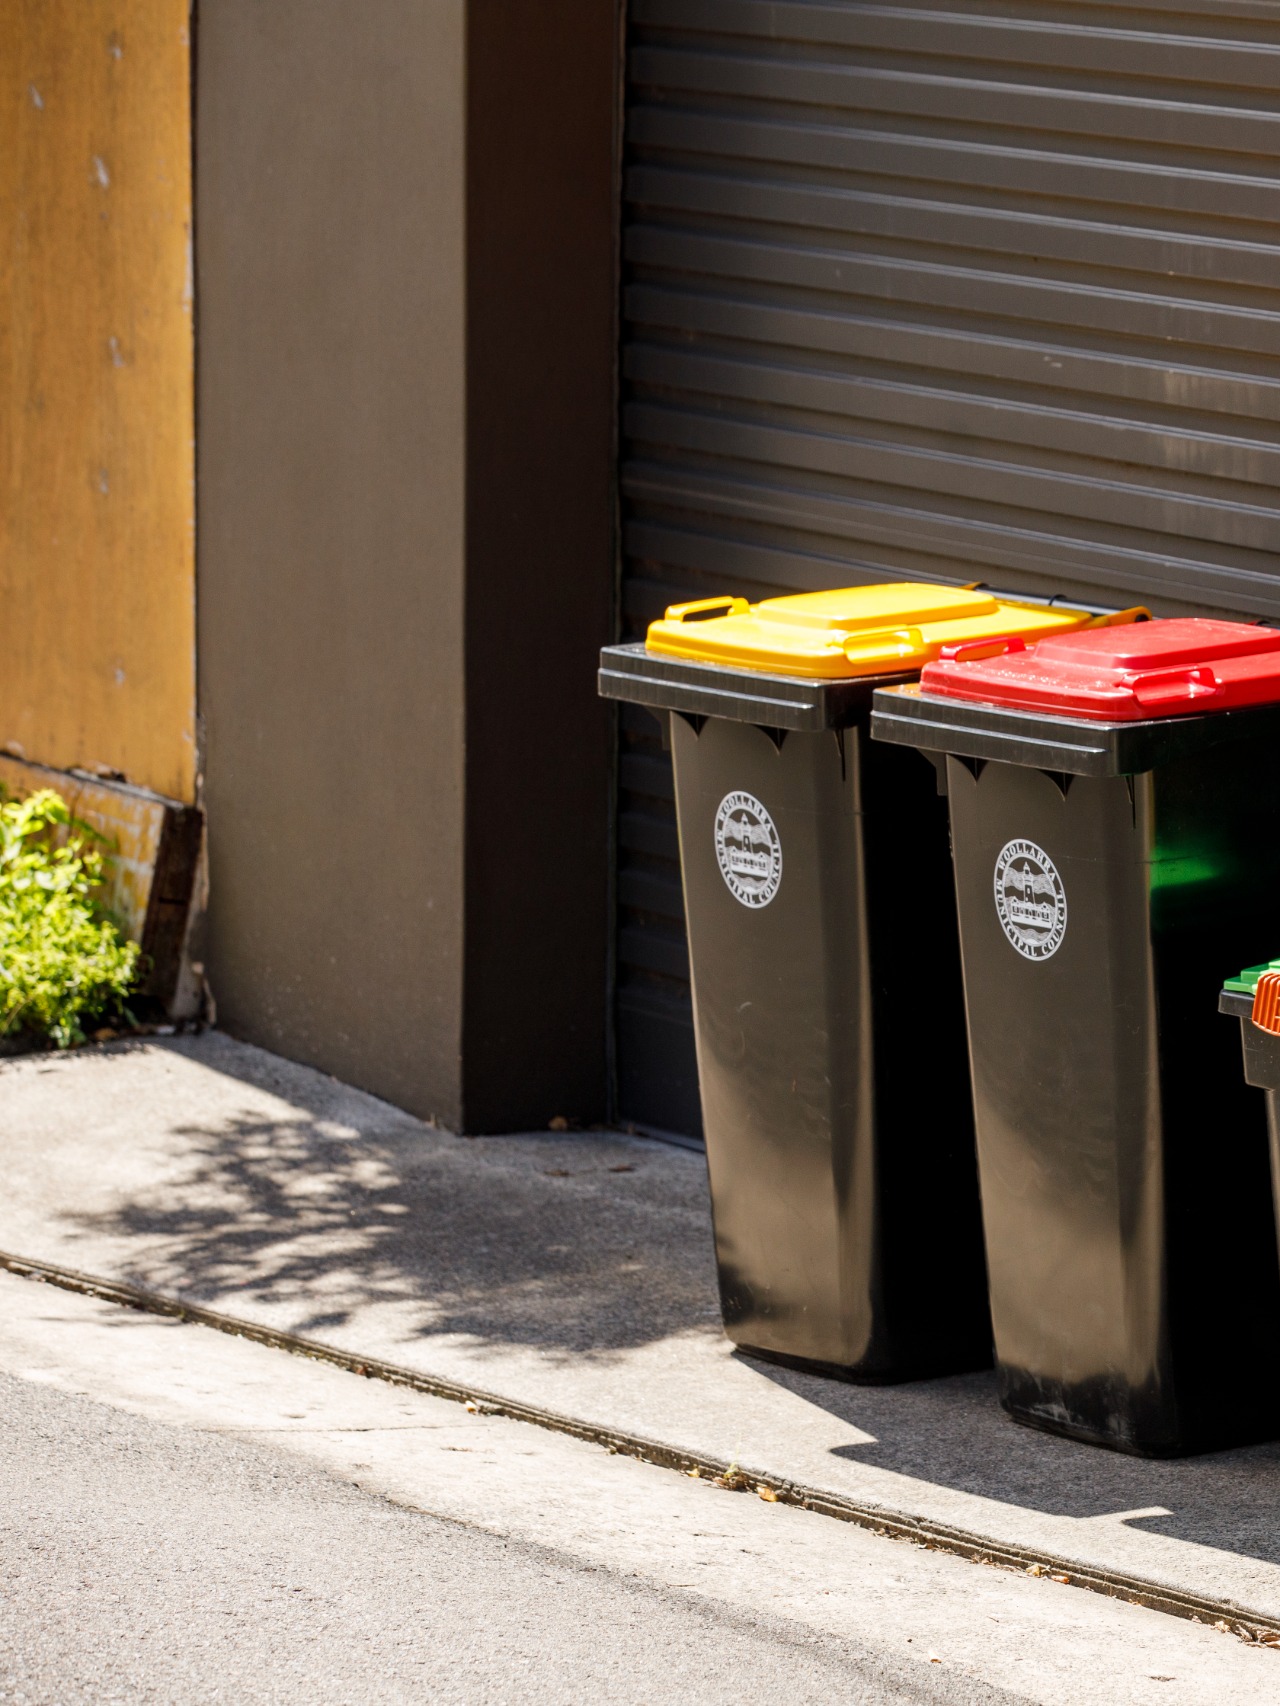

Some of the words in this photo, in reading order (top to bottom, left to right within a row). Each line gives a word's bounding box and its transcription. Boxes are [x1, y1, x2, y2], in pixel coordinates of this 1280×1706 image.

[719, 795, 771, 832] WOOLLAHRA
[717, 830, 755, 904] MUNICIPAL
[759, 839, 779, 902] COUNCIL
[998, 843, 1055, 881] WOOLLAHRA
[996, 880, 1037, 956] MUNICIPAL
[1042, 889, 1064, 955] COUNCIL
